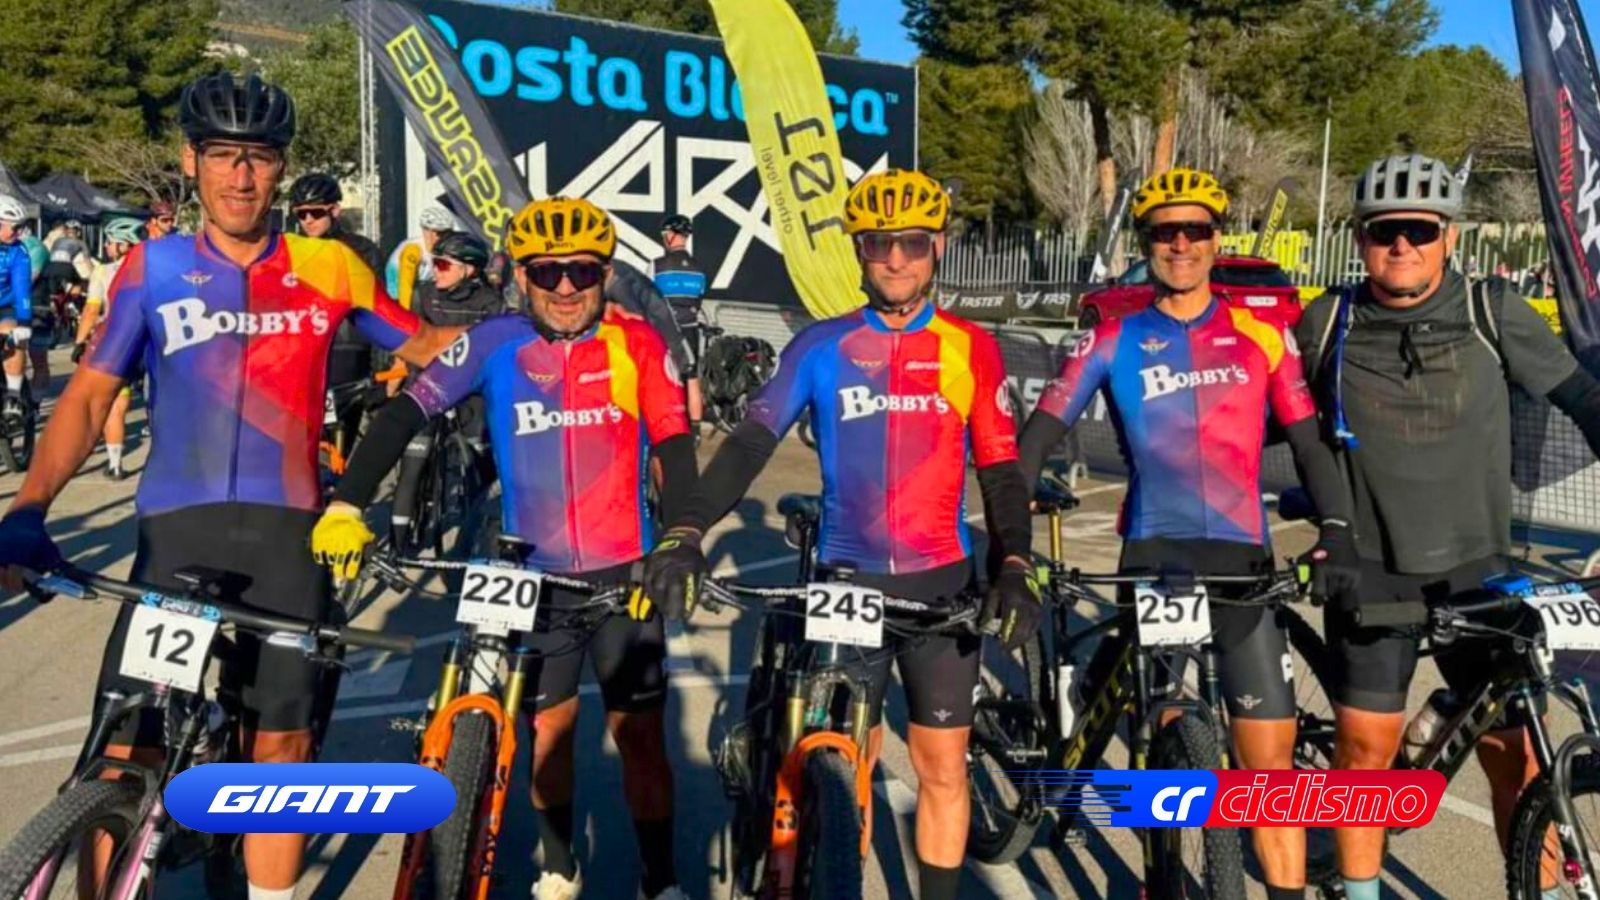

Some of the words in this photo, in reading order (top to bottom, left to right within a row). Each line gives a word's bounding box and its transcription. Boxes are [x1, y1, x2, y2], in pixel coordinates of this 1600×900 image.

[428, 14, 648, 112] osta
[664, 49, 889, 136] Blca
[959, 296, 1005, 308] FASTER
[156, 297, 330, 356] BOBBY'S
[1138, 364, 1250, 401] BOBBY'S
[513, 400, 623, 436] BOBBY'S
[838, 384, 950, 422] BOBBY'S
[462, 572, 539, 610] 220
[807, 589, 883, 624] 245
[1138, 592, 1206, 625] 257
[1540, 599, 1600, 628] 196
[144, 622, 196, 667] 12
